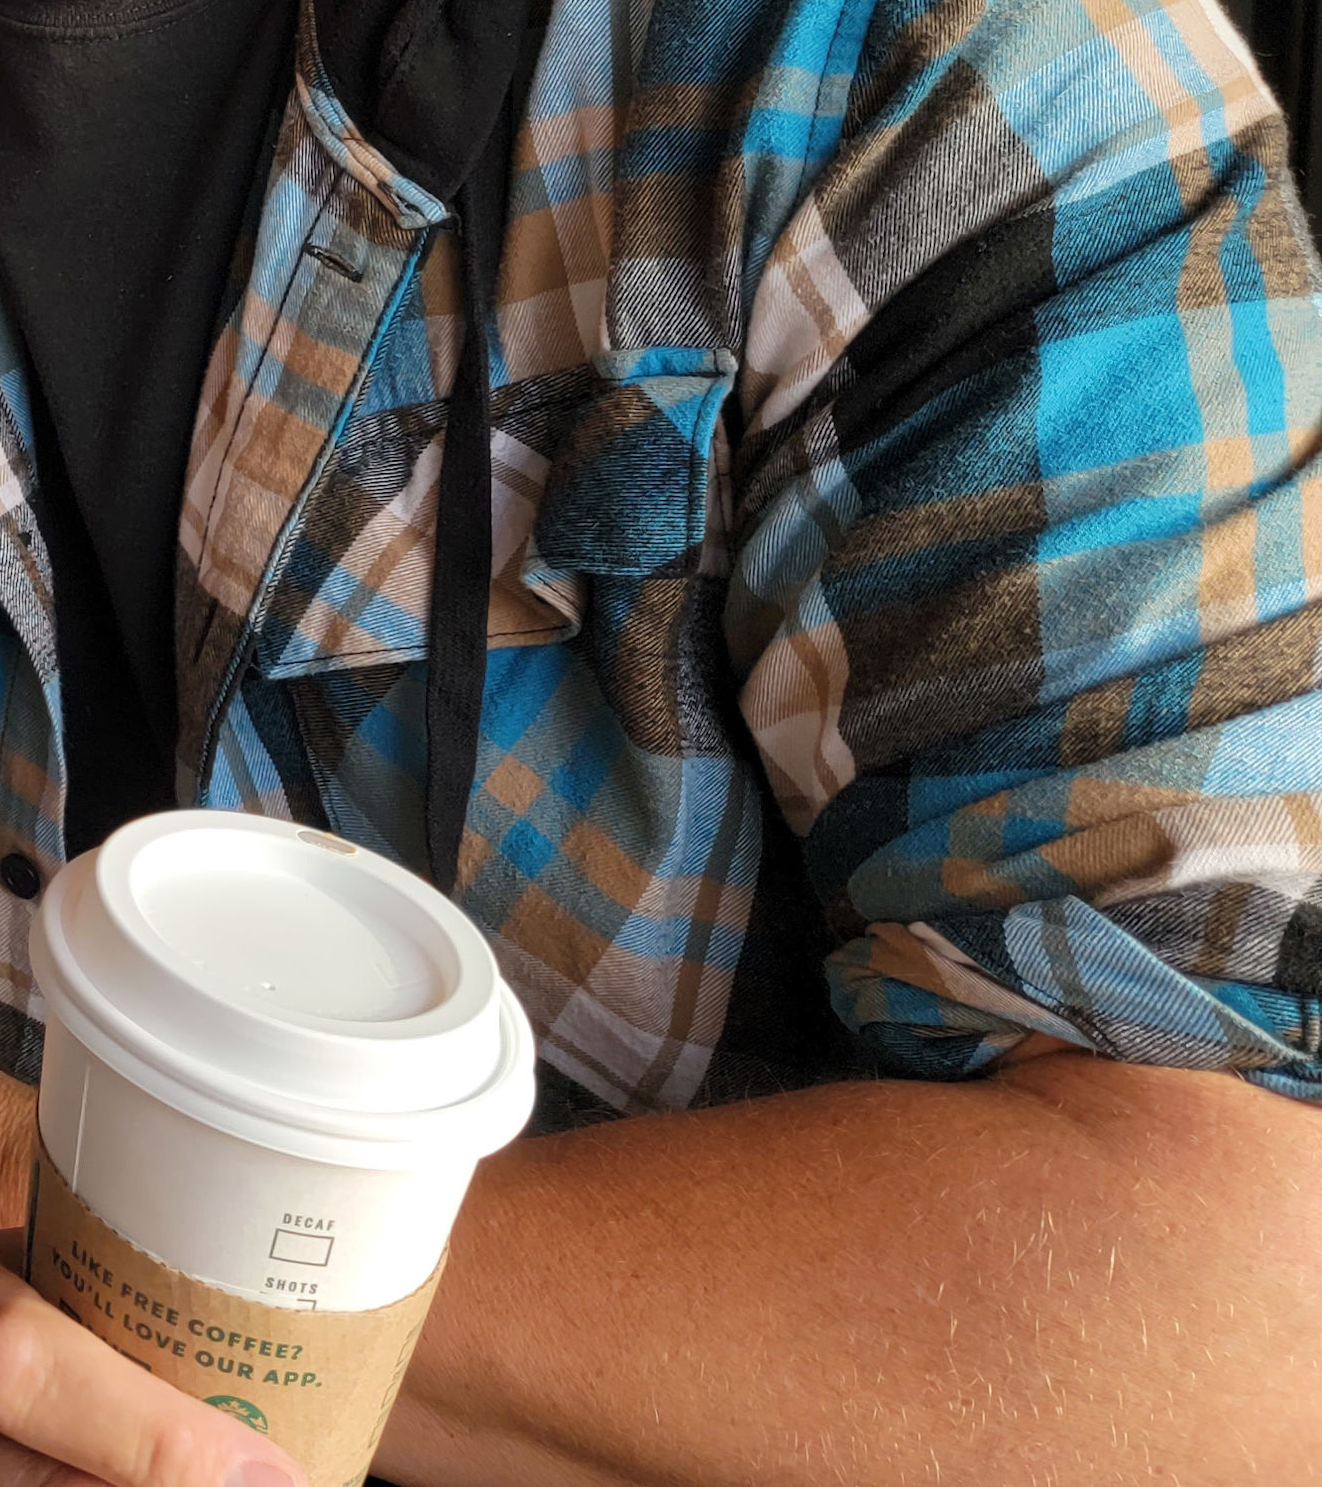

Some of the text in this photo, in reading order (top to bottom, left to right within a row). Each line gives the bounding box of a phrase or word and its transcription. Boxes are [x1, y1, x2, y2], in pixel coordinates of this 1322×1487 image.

[283, 1212, 337, 1232] DECAF
[51, 1247, 323, 1389] YOU'LL LOVE OUR APP.
[71, 1240, 304, 1362] LIKE FREE COFFEE?
[264, 1276, 320, 1295] SHOTS
